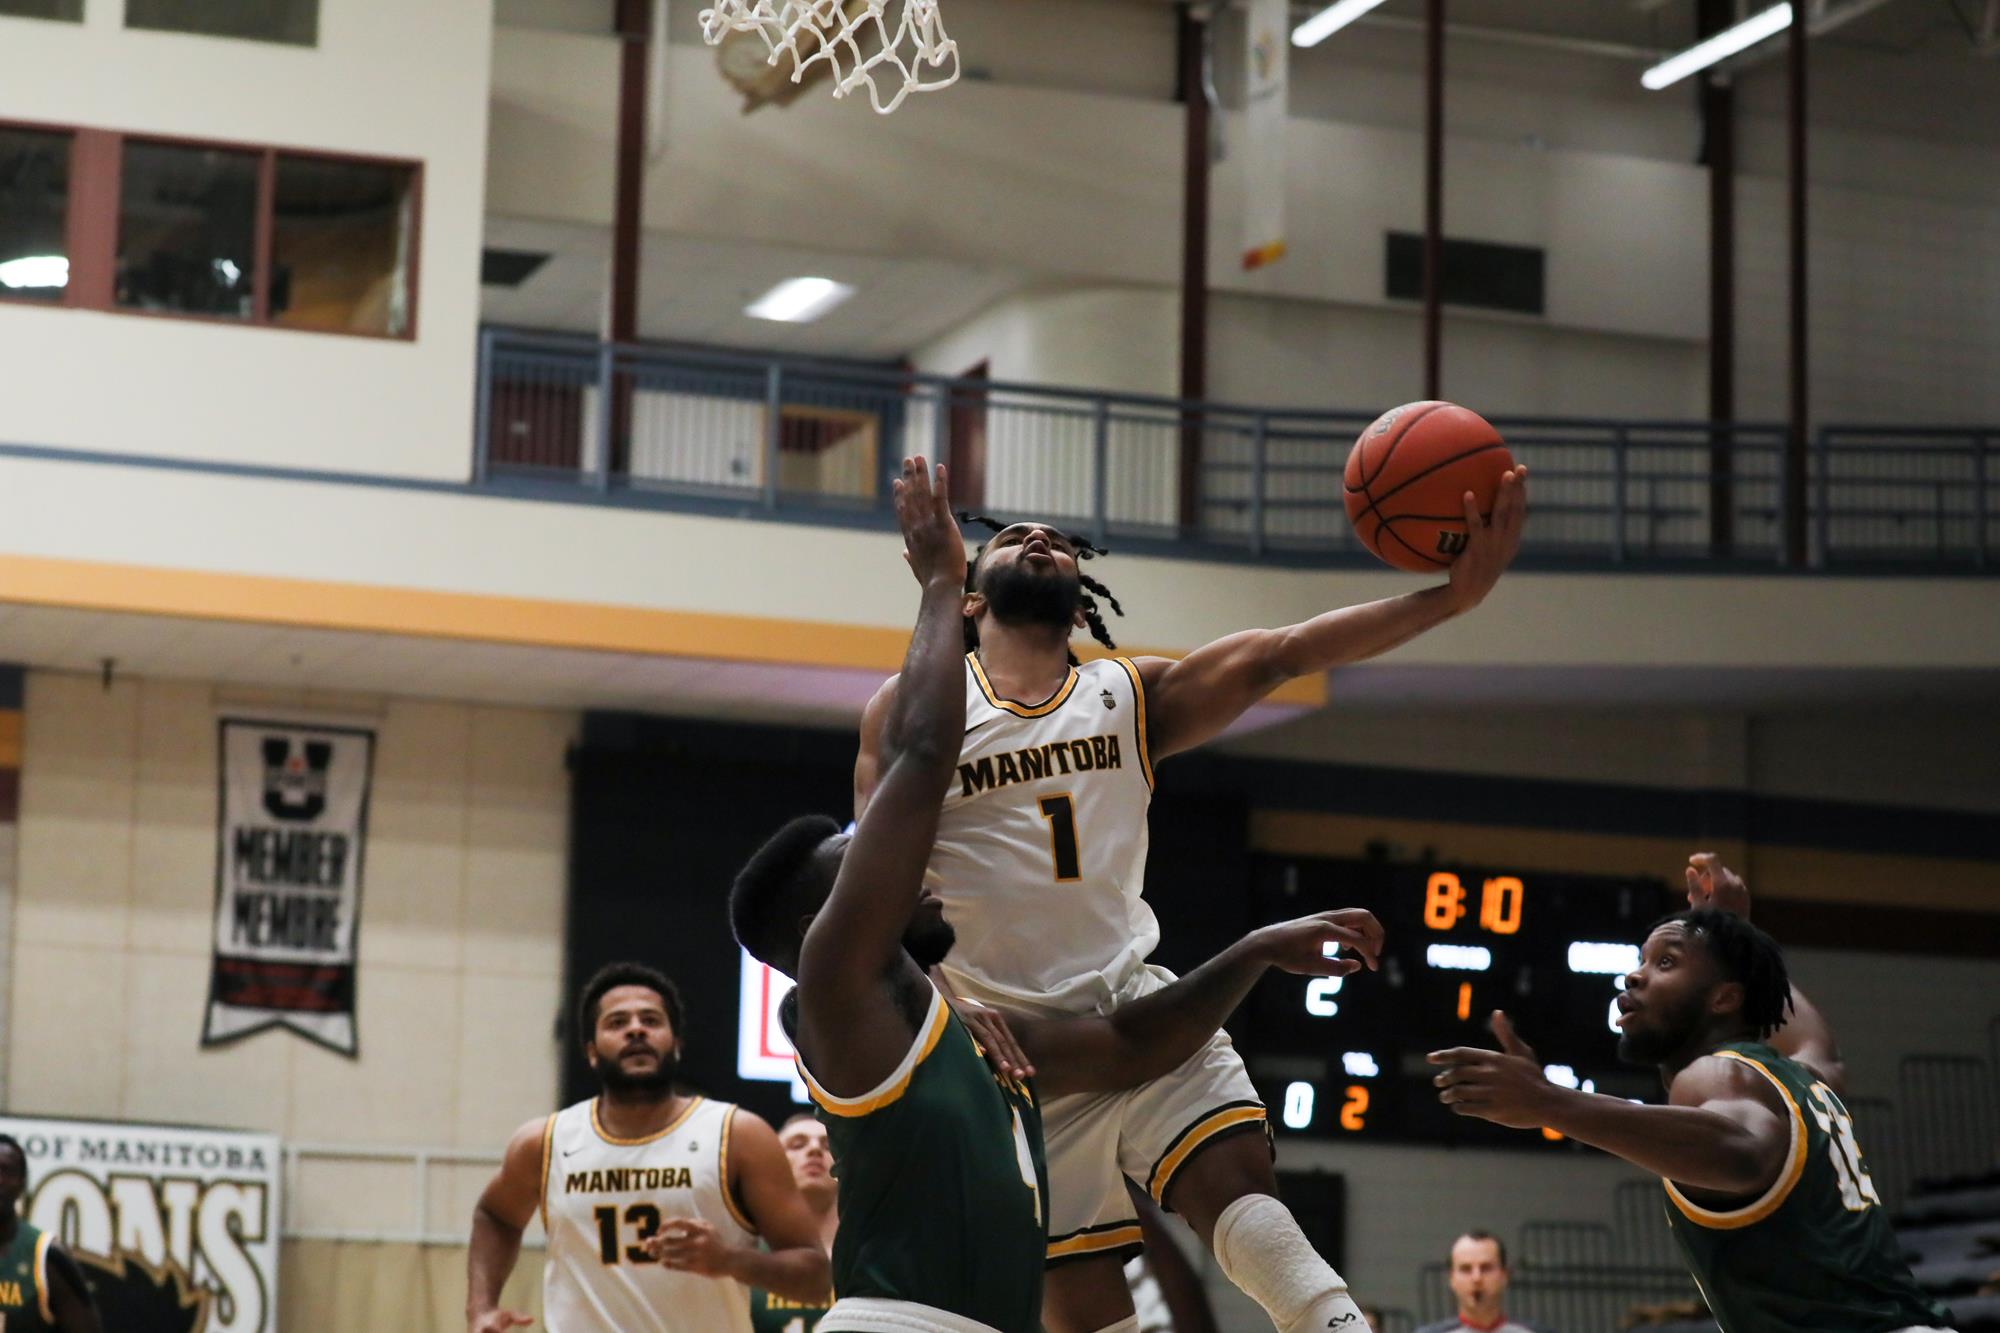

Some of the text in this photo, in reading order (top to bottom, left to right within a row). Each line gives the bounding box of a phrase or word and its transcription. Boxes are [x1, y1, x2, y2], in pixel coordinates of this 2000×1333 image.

[957, 734, 1122, 797] MANITOBA
[233, 826, 348, 888] MEMBER
[1037, 791, 1082, 883] 1
[1423, 871, 1524, 935] 8:10
[1456, 981, 1473, 1021] 1
[1283, 1081, 1315, 1129] 0
[1339, 1084, 1370, 1131] 2
[26, 1136, 267, 1170] OF MANITOBA
[565, 1168, 692, 1194] MANITOBA
[593, 1202, 660, 1266] 13
